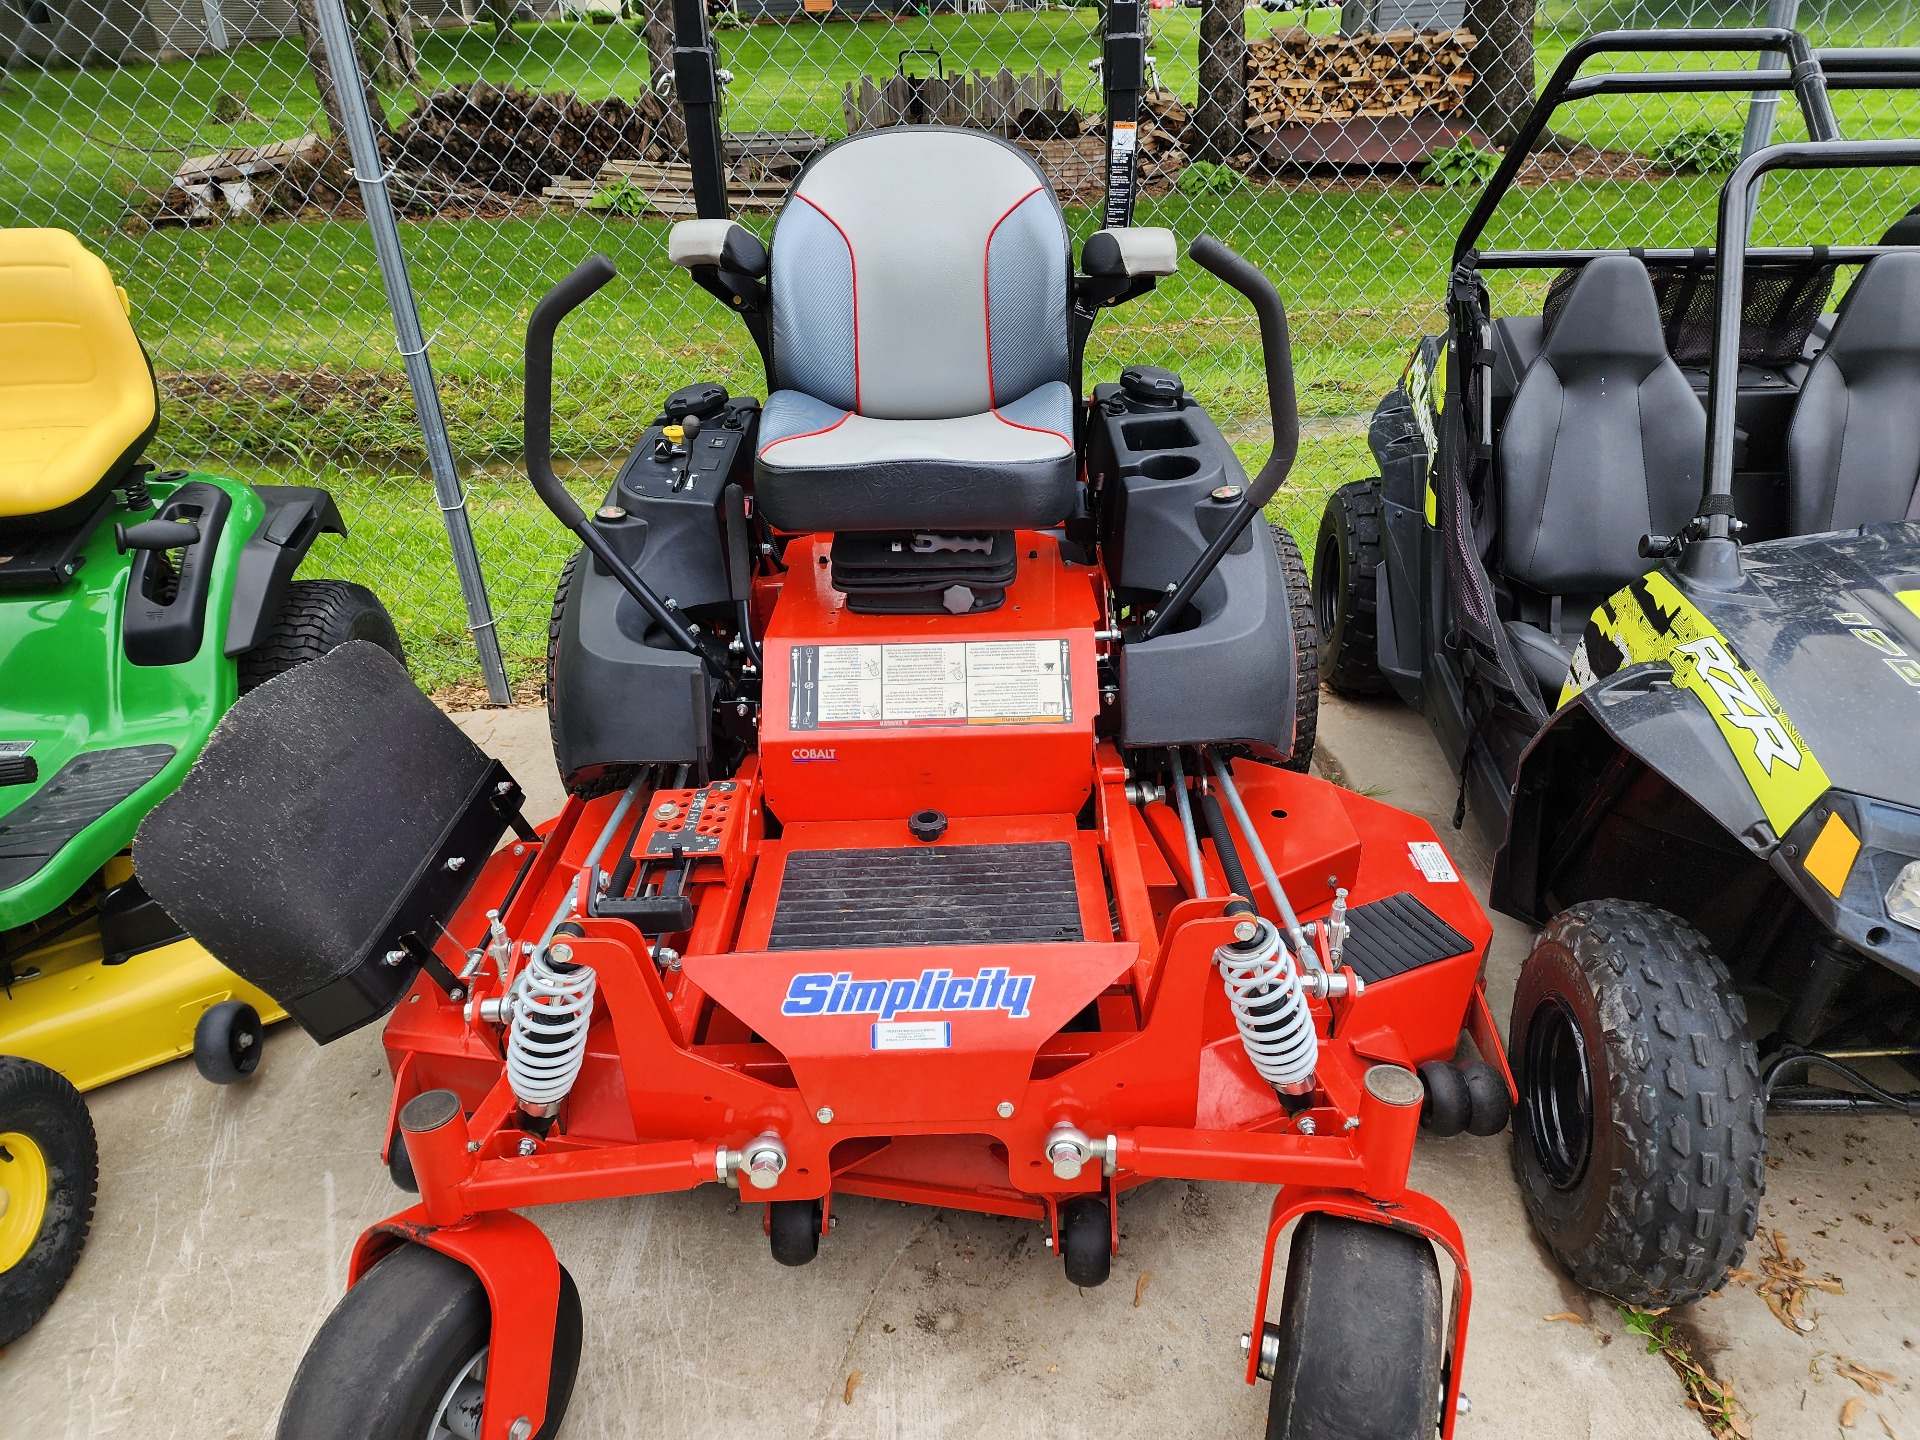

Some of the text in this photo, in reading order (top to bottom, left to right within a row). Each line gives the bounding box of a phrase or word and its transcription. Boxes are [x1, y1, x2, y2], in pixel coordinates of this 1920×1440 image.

[1675, 637, 1803, 778] RZR
[791, 748, 837, 760] COBALT
[782, 967, 1036, 1021] Simplicity
